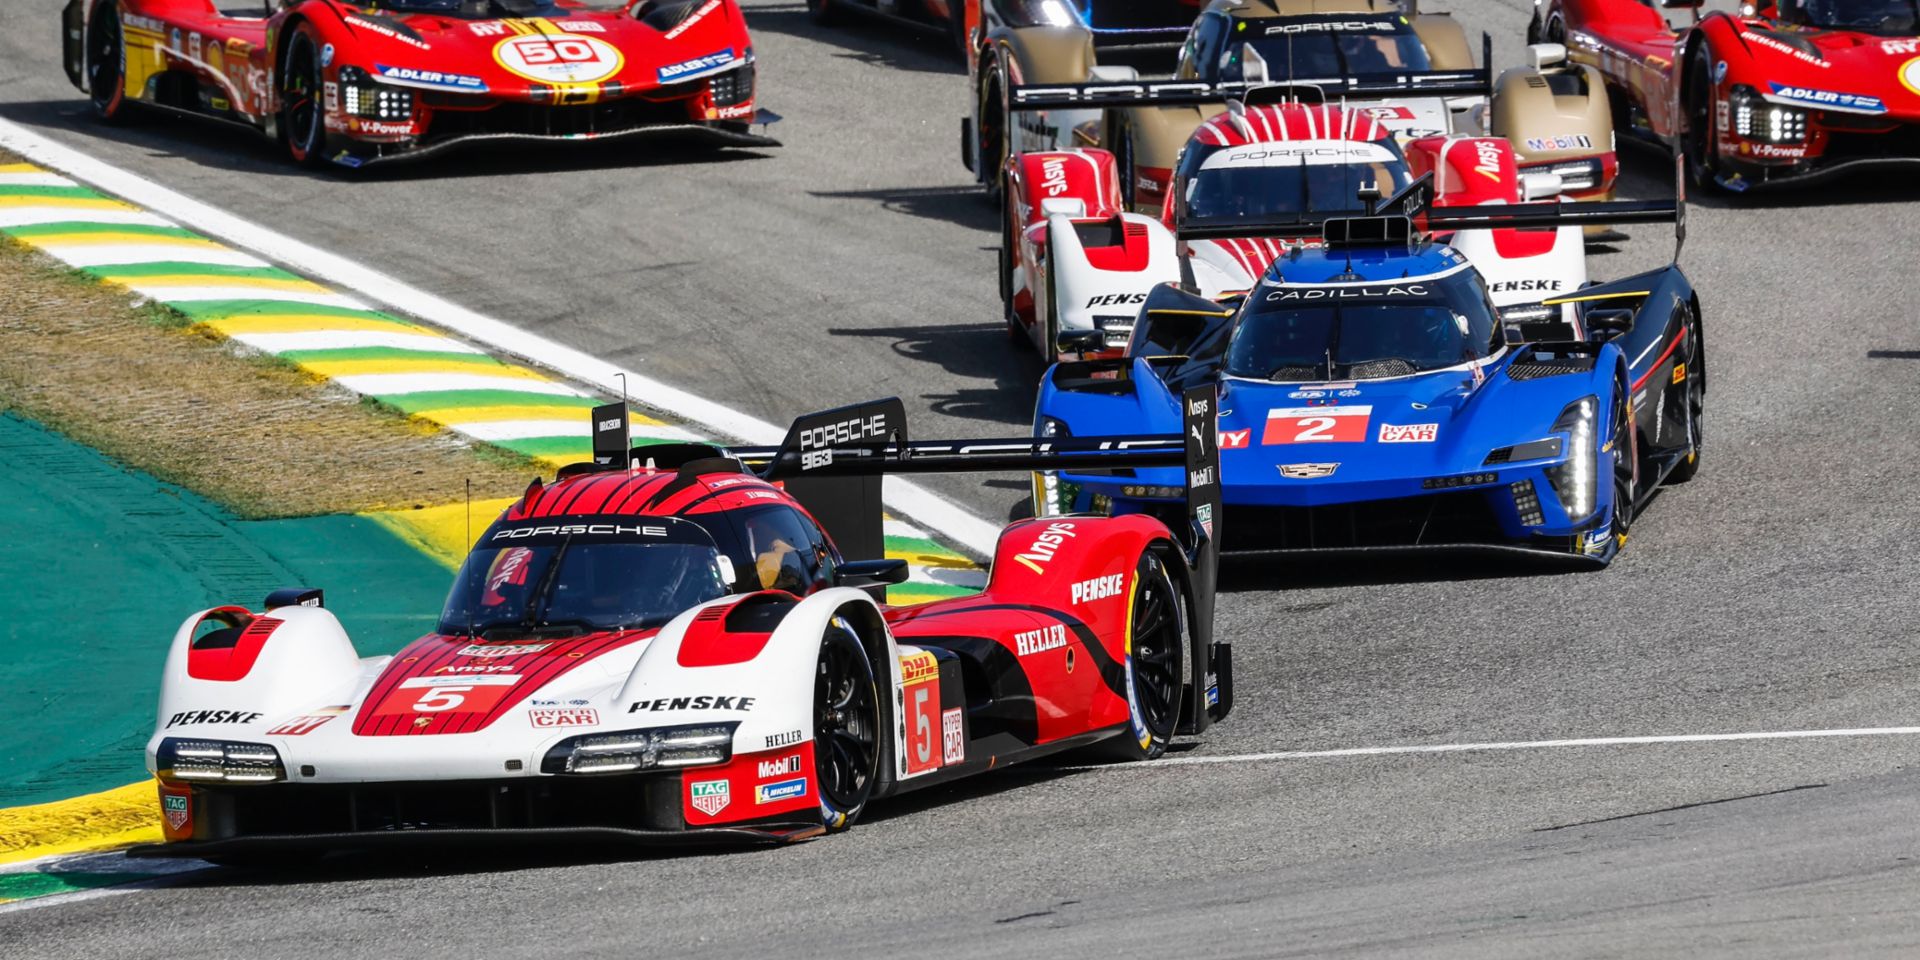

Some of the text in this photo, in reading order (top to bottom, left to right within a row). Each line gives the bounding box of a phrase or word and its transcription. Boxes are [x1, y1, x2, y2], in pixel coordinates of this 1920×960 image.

[344, 16, 395, 37] RICHARD
[1265, 21, 1396, 35] PORSCHE
[518, 41, 593, 63] 50
[1740, 31, 1832, 69] RICHARD MILLE
[384, 67, 442, 82] ADLER
[660, 59, 706, 78] ADLER
[1775, 86, 1838, 103] ADLER
[361, 121, 413, 133] V-Power
[1527, 136, 1576, 151] Mobil
[1752, 144, 1807, 157] V-Power
[1230, 148, 1373, 162] PORSCHE
[1474, 141, 1503, 183] Ansys
[1041, 157, 1068, 196] Ansys
[1266, 286, 1428, 301] CADILLAC
[1486, 279, 1562, 293] ENSKE
[1188, 399, 1208, 417] Ansys
[800, 414, 886, 452] PORSCHE
[1294, 417, 1337, 442] 2
[1382, 430, 1434, 441] CAR
[802, 448, 833, 470] 963
[1190, 468, 1207, 489] Mobil
[491, 524, 668, 541] PORSCHE
[1014, 521, 1076, 575] Ansys
[1071, 573, 1123, 605] PENSKE
[1014, 623, 1067, 657] HELLER
[433, 664, 515, 673] Ansys
[902, 656, 934, 680] DHL
[412, 686, 473, 712] 5
[627, 695, 756, 714] PENSKE
[165, 710, 264, 730] PENSKE
[533, 709, 592, 717] HYPER
[536, 715, 594, 726] CAR
[944, 712, 961, 733] HYPER
[915, 687, 931, 763] 5
[765, 729, 802, 748] HELLER
[945, 731, 964, 760] CAR
[758, 755, 801, 779] Mobil 1
[697, 780, 728, 795] TAG
[769, 783, 803, 798] MICHELIN
[166, 798, 186, 810] TAG
[693, 795, 730, 813] HEUER
[166, 810, 188, 826] HEUER
